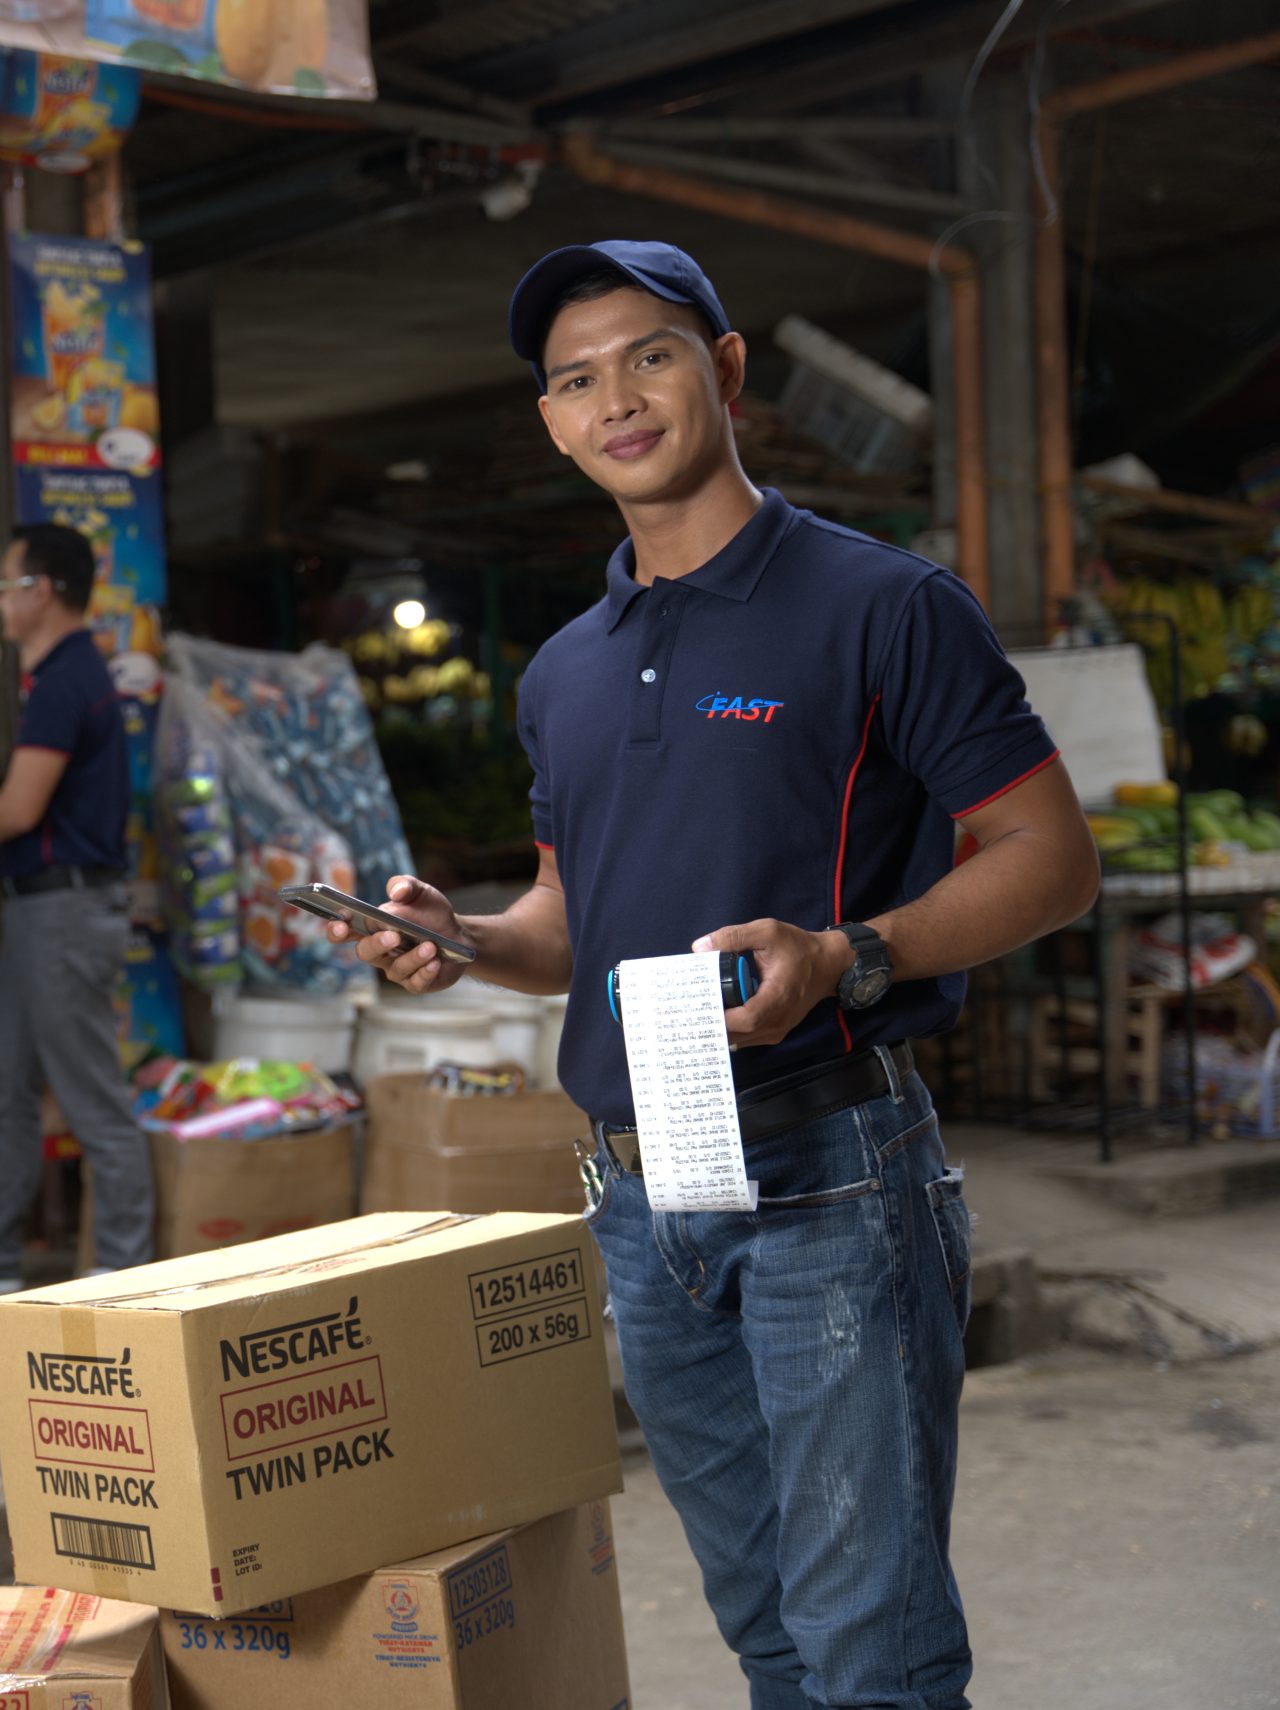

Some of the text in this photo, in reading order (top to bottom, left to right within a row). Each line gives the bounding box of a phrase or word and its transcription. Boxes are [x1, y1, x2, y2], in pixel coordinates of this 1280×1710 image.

[706, 696, 784, 723] FAST
[474, 1259, 578, 1309] 12514461
[219, 1296, 364, 1382] NESCAFÉ
[489, 1312, 579, 1355] 200 x 56g
[27, 1347, 135, 1398] NESCAFÉ
[233, 1378, 376, 1439] ORIGINAL
[37, 1416, 145, 1455] ORIGINAL
[226, 1428, 394, 1501] TWIN PACK
[35, 1466, 159, 1509] TWIN PACK
[232, 1543, 260, 1557] EXPIRY
[234, 1554, 257, 1567] DATE:
[235, 1565, 250, 1577] LOT
[454, 1557, 507, 1609] 12503128
[179, 1623, 291, 1660] 36 x 320g
[456, 1618, 473, 1650] 36
[484, 1599, 516, 1634] 320g
